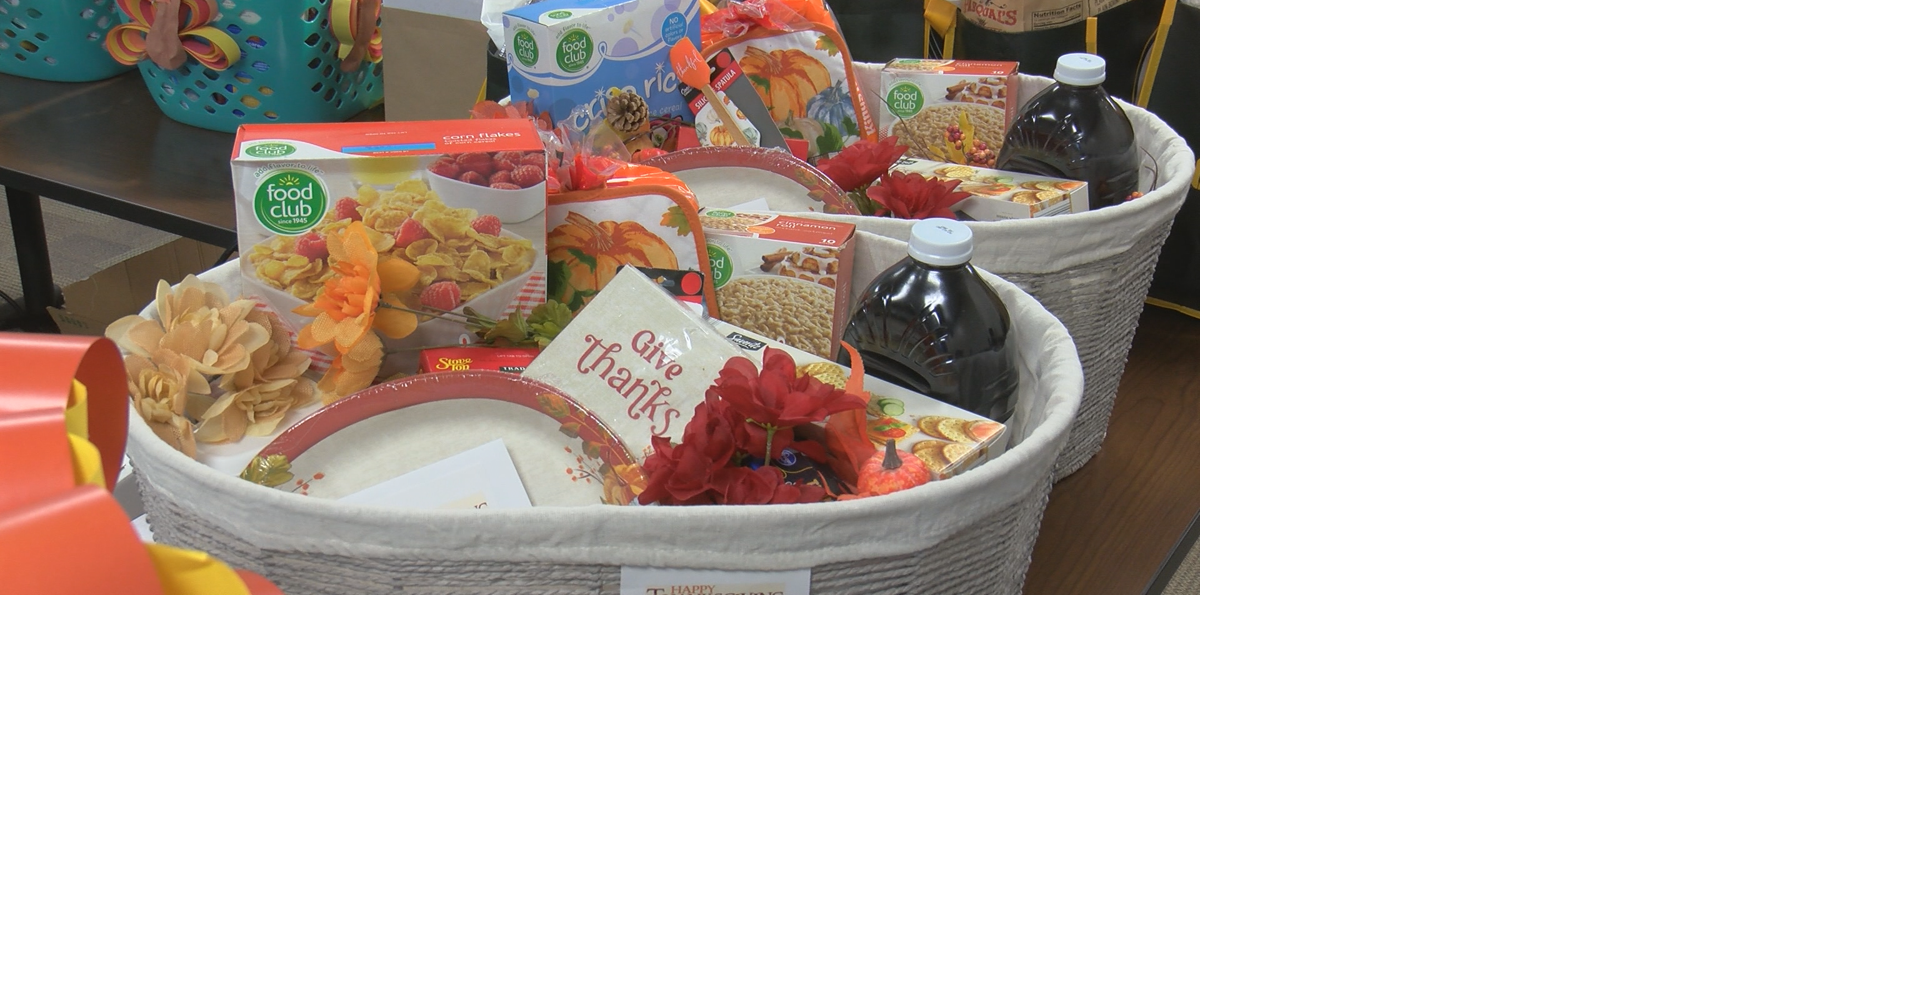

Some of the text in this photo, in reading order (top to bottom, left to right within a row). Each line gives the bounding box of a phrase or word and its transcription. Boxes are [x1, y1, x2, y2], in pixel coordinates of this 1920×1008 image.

[1033, 9, 1065, 18] Nutrition
[1065, 4, 1081, 13] Facts
[517, 36, 534, 51] food
[562, 36, 587, 54] food
[518, 47, 535, 60] club
[564, 49, 587, 64] club
[644, 61, 680, 98] ric
[714, 68, 737, 92] SPATULA
[893, 89, 918, 100] food
[660, 104, 683, 118] cereal
[894, 99, 917, 110] club
[254, 166, 270, 178] add
[269, 162, 295, 170] flavor
[267, 182, 313, 201] food
[270, 201, 312, 218] club
[778, 220, 836, 230] cinnamon
[631, 329, 683, 380] Give
[436, 357, 473, 370] Stove
[670, 585, 716, 595] HAPPY
